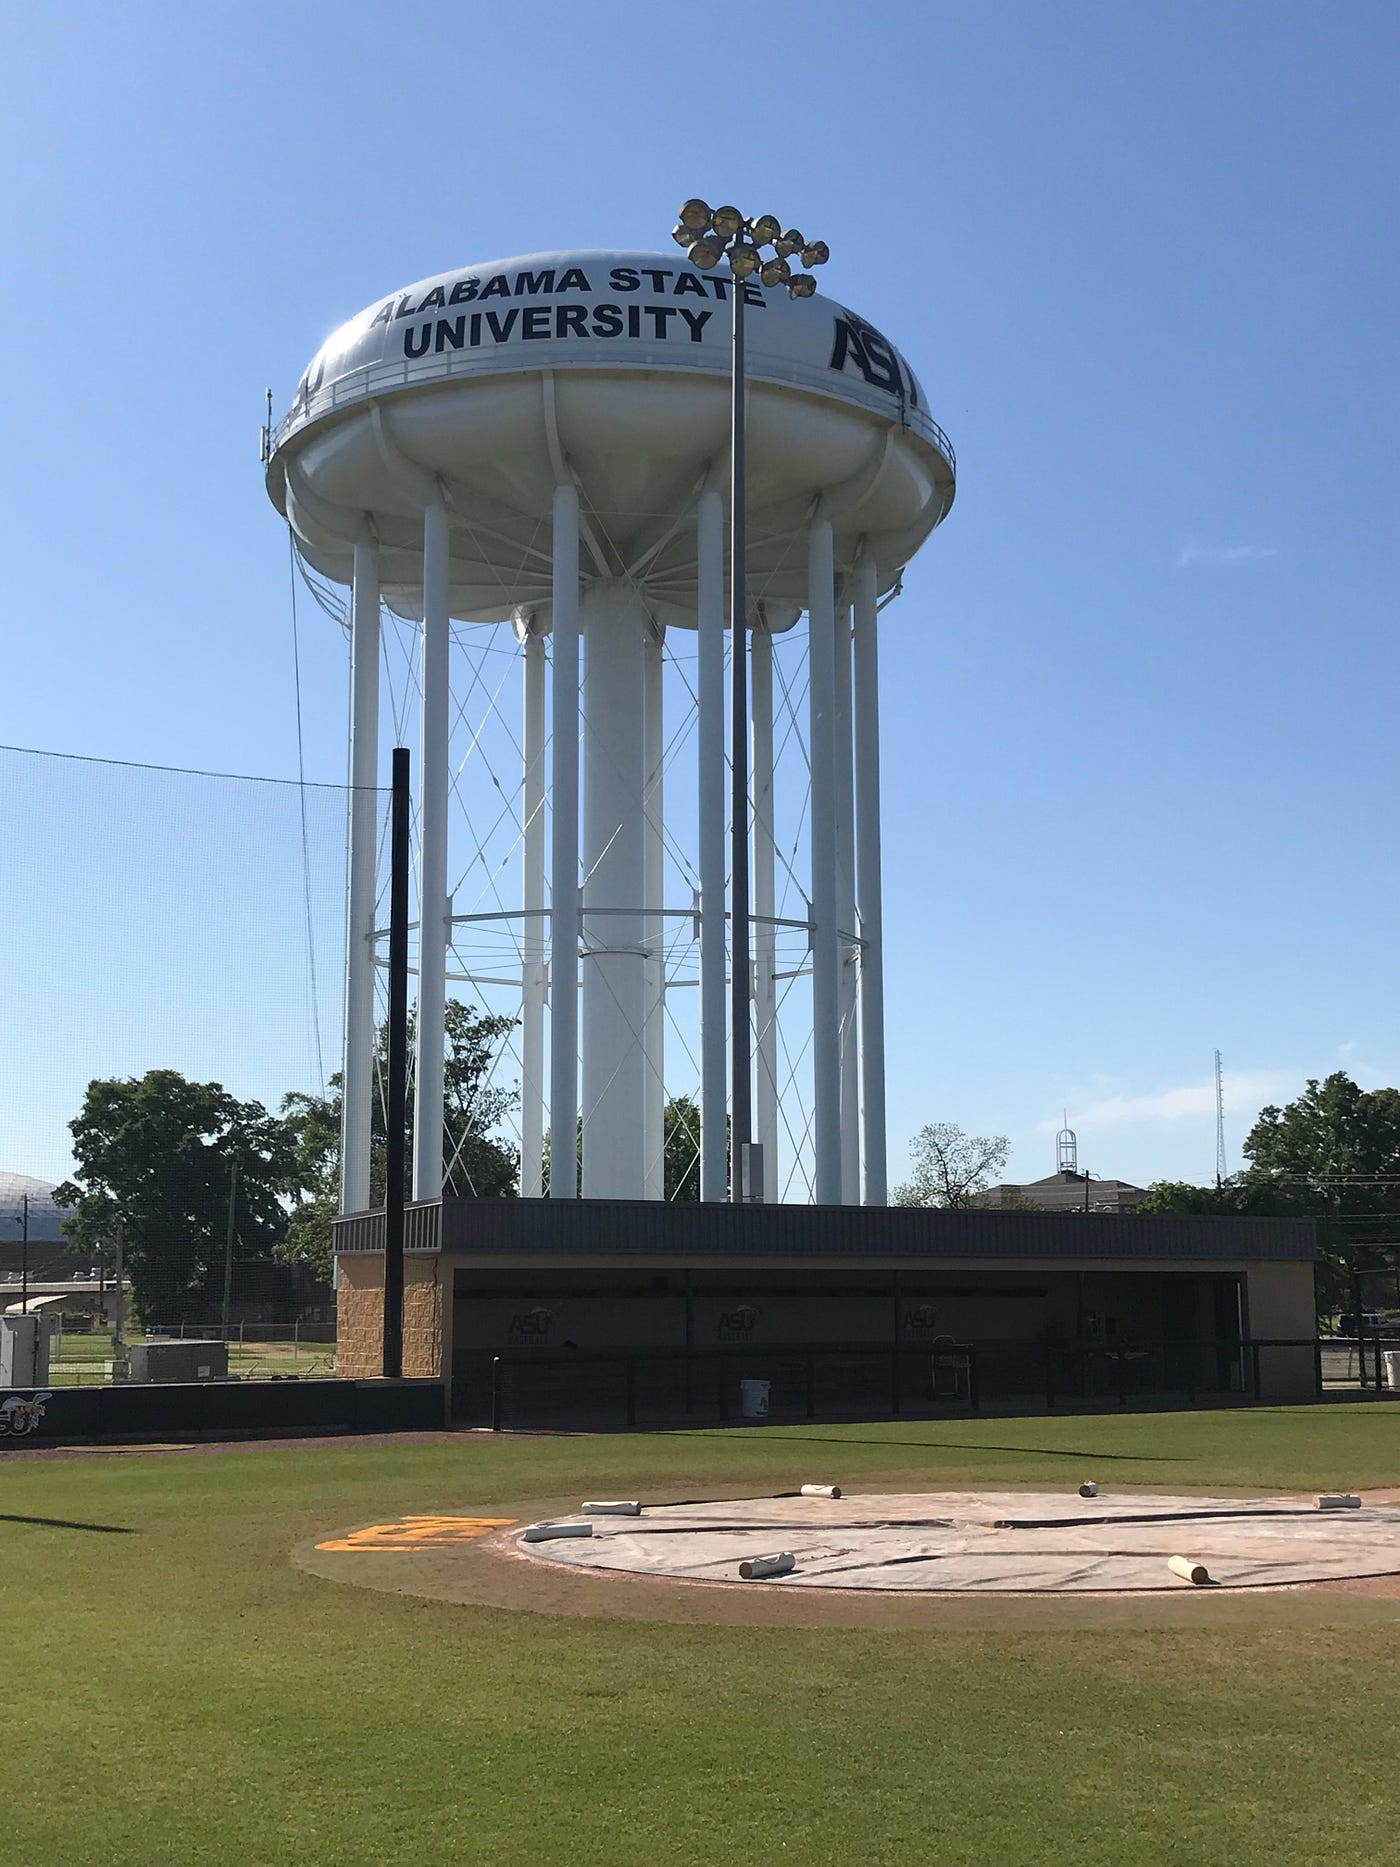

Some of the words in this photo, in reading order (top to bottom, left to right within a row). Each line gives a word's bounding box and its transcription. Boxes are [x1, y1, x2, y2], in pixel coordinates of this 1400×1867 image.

[369, 269, 592, 328] ALABAMA
[609, 267, 767, 309] STATE
[404, 303, 713, 359] UNIVERSITY
